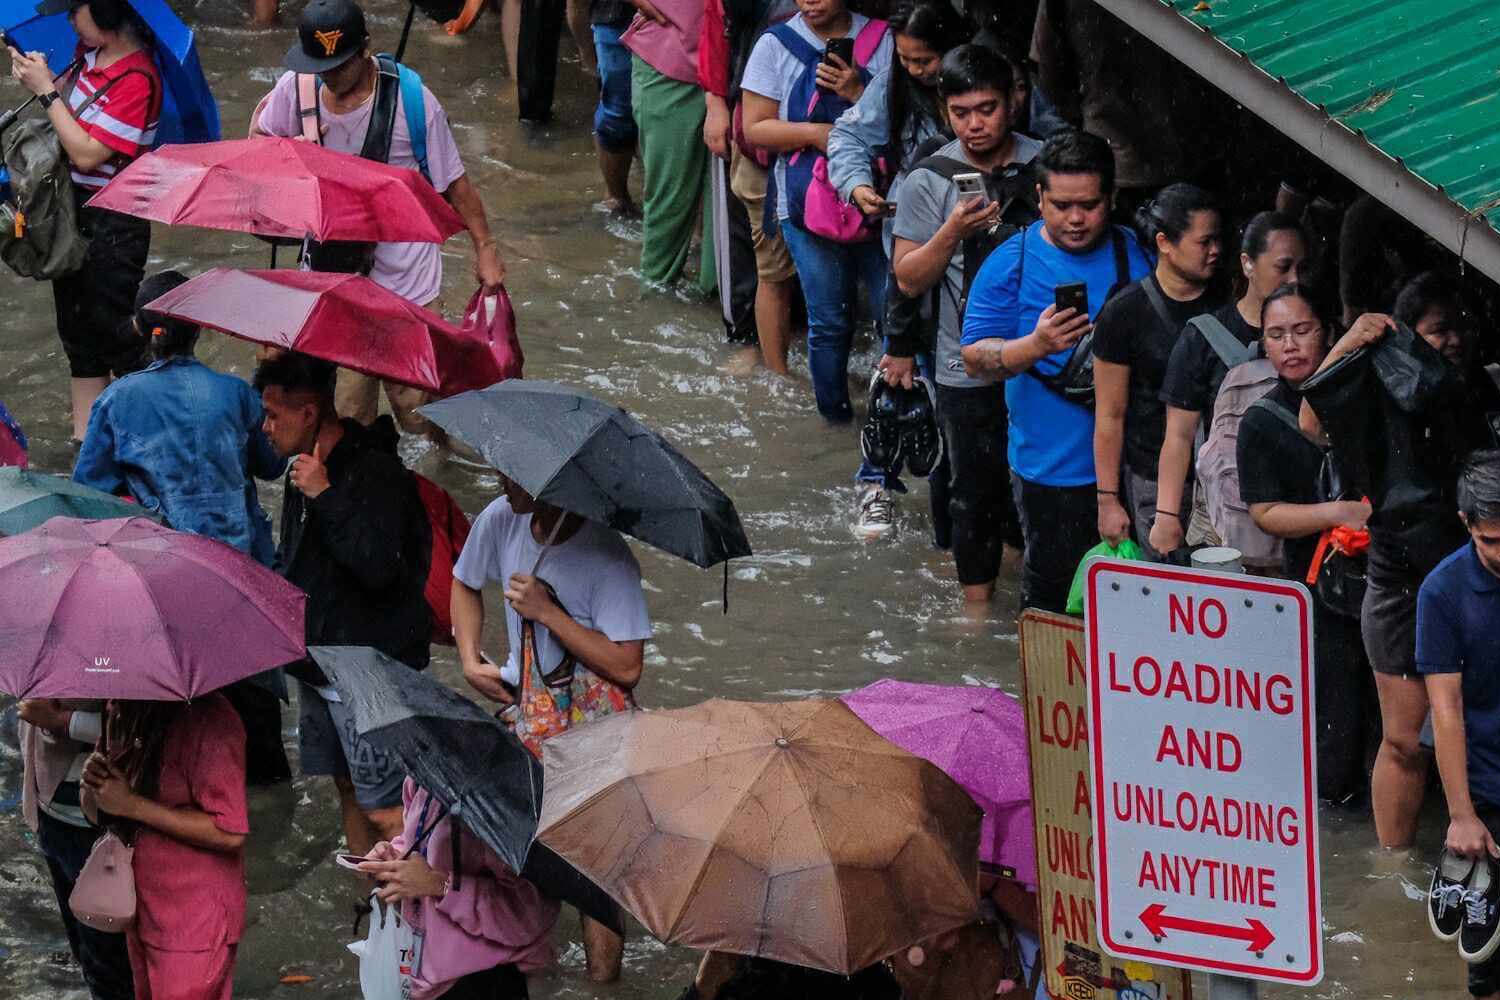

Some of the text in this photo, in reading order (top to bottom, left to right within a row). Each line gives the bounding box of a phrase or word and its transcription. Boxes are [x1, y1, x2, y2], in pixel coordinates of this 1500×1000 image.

[1168, 594, 1229, 639] NO
[94, 656, 111, 666] UV
[1108, 651, 1295, 716] LOADING
[1155, 724, 1243, 773] AND
[1112, 782, 1300, 847] UNLOADING
[1137, 851, 1276, 909] ANYTIME
